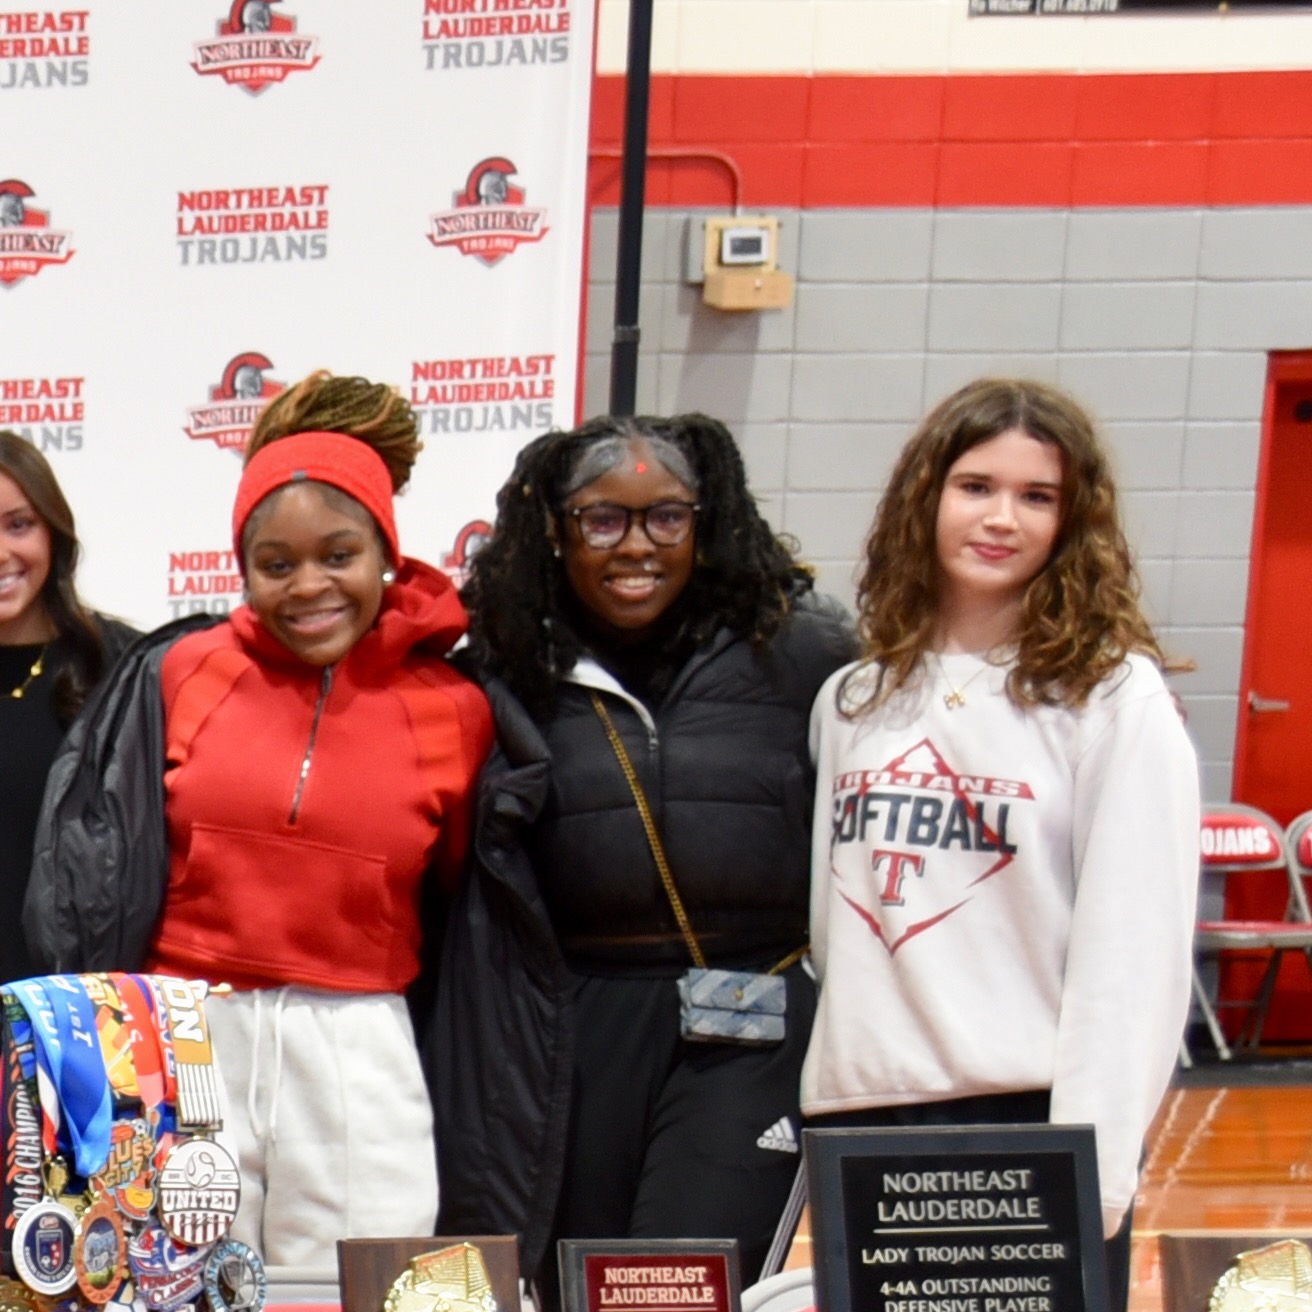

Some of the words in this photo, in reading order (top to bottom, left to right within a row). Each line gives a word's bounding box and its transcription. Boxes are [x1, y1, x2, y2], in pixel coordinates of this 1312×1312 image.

[423, 12, 571, 40] LAUDERDALE
[201, 40, 309, 66] NORTHEAST
[423, 36, 570, 70] TROJANS
[177, 185, 328, 211] NORTHEAST
[177, 209, 328, 236] LAUDERDALE
[435, 212, 539, 236] NORTHEAST
[177, 233, 327, 266] TROJANS
[412, 354, 555, 381] NORTHEAST
[411, 379, 554, 405] LAUDERDALE
[1200, 826, 1272, 856] OJANS
[872, 849, 925, 906] T
[756, 1137, 798, 1153] adidas
[883, 1169, 1031, 1194] NORTHEAST
[161, 1190, 238, 1210] UNITED
[877, 1198, 1041, 1222] LAUDERDALE
[862, 1247, 908, 1265] LADY
[914, 1245, 984, 1264] TROJAN
[990, 1243, 1065, 1262] SOCCER
[604, 1267, 707, 1285] NORTHEAST
[880, 1280, 917, 1296] 4-4A
[922, 1276, 1051, 1295] OUTSTANDING
[601, 1286, 715, 1305] LAUDERDALE
